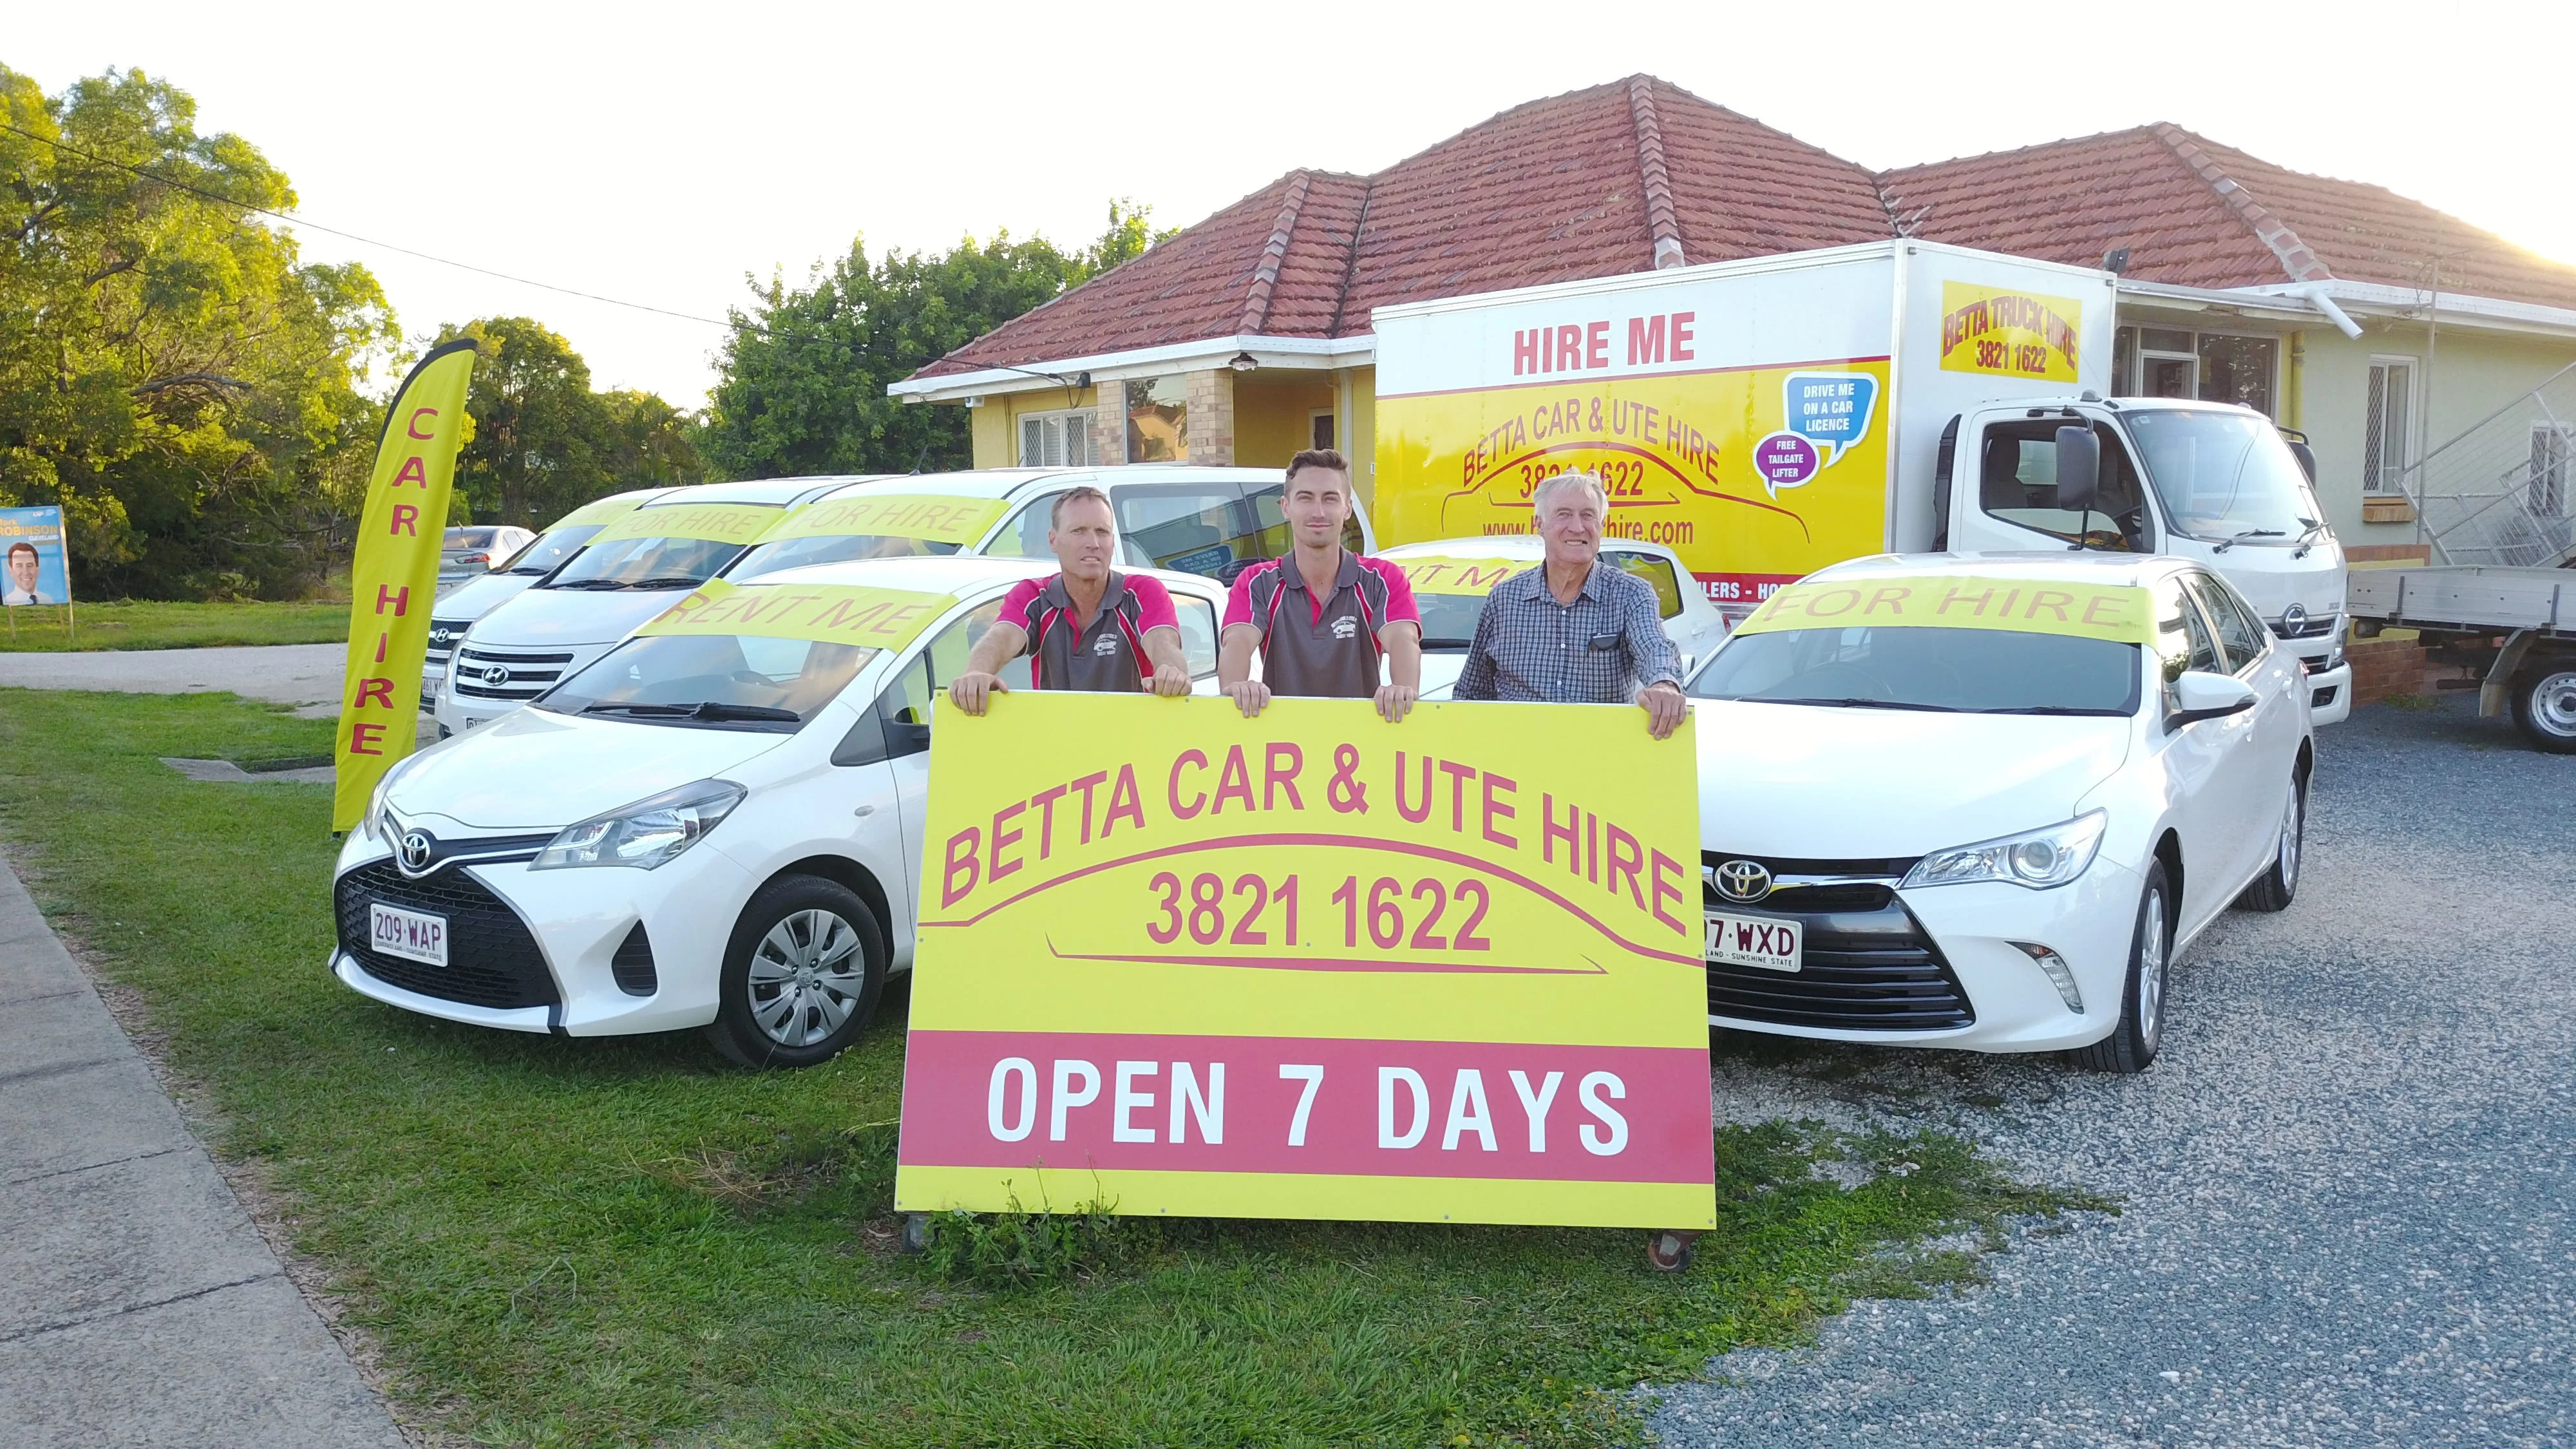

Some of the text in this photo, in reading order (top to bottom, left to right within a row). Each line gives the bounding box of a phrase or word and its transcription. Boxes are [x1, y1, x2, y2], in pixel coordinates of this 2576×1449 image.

[1513, 312, 1695, 375] HIRE ME
[1943, 296, 2077, 372] BETTA TRUCK HIRE
[1976, 339, 2047, 373] 3821 1622
[1804, 383, 1855, 398] DRIVE ME
[1803, 401, 1853, 415] ON A CAR
[1806, 418, 1850, 432] LICENCE
[1463, 396, 1719, 488] BETTA CAR & UTE HIRE
[1768, 453, 1804, 464] TAILGATE
[1776, 440, 1796, 450] FREE
[1587, 461, 1643, 496] 622
[1772, 468, 1799, 477] LIFTER
[622, 513, 674, 533] FOR
[675, 511, 761, 535] HIRE
[792, 503, 979, 533] FOR HIRE
[350, 408, 439, 755] CAR HIRE
[653, 591, 933, 634] RENT ME
[1762, 586, 2130, 627] FOR HIRE
[941, 742, 1687, 937] BETTA CAR & UTE HIRE
[1146, 871, 1491, 951] 3821 1622
[1731, 952, 1766, 963] SUNSHINE
[1771, 958, 1793, 967] STATE
[987, 1056, 1629, 1157] OPEN 7 DAYS
